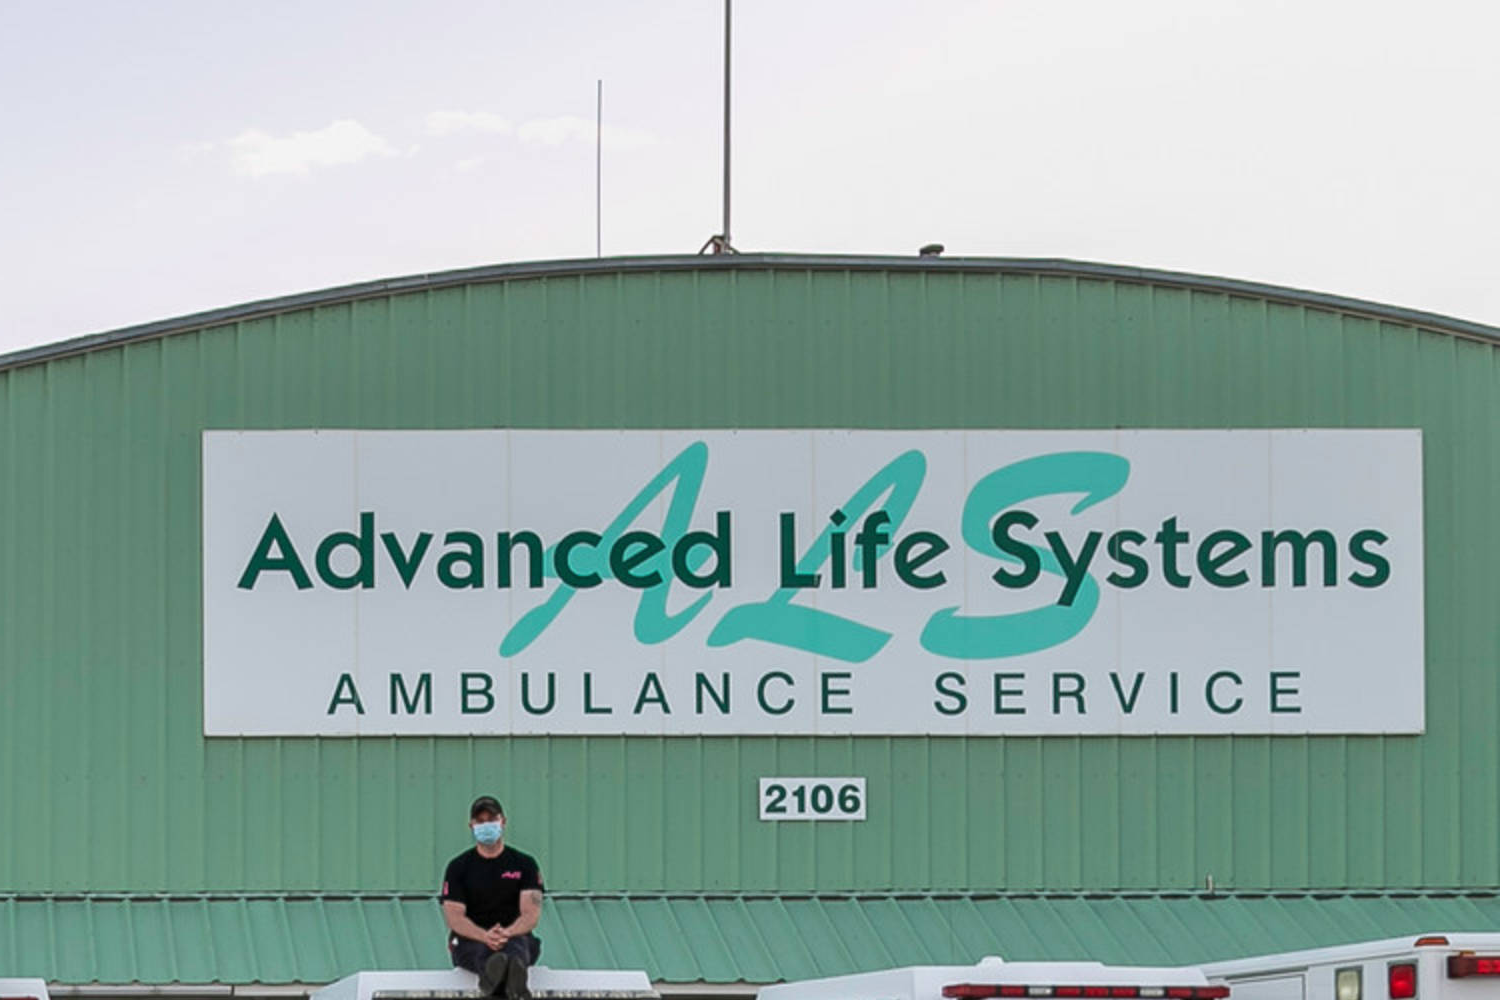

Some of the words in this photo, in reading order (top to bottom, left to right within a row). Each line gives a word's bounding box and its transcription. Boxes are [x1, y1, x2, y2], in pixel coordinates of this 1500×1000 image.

[237, 510, 732, 590] Advanced
[779, 509, 950, 590] Life
[991, 509, 1391, 607] Systems
[327, 671, 854, 716] AMBULANCE
[933, 671, 1303, 716] SERVICE
[764, 784, 862, 814] 2106
